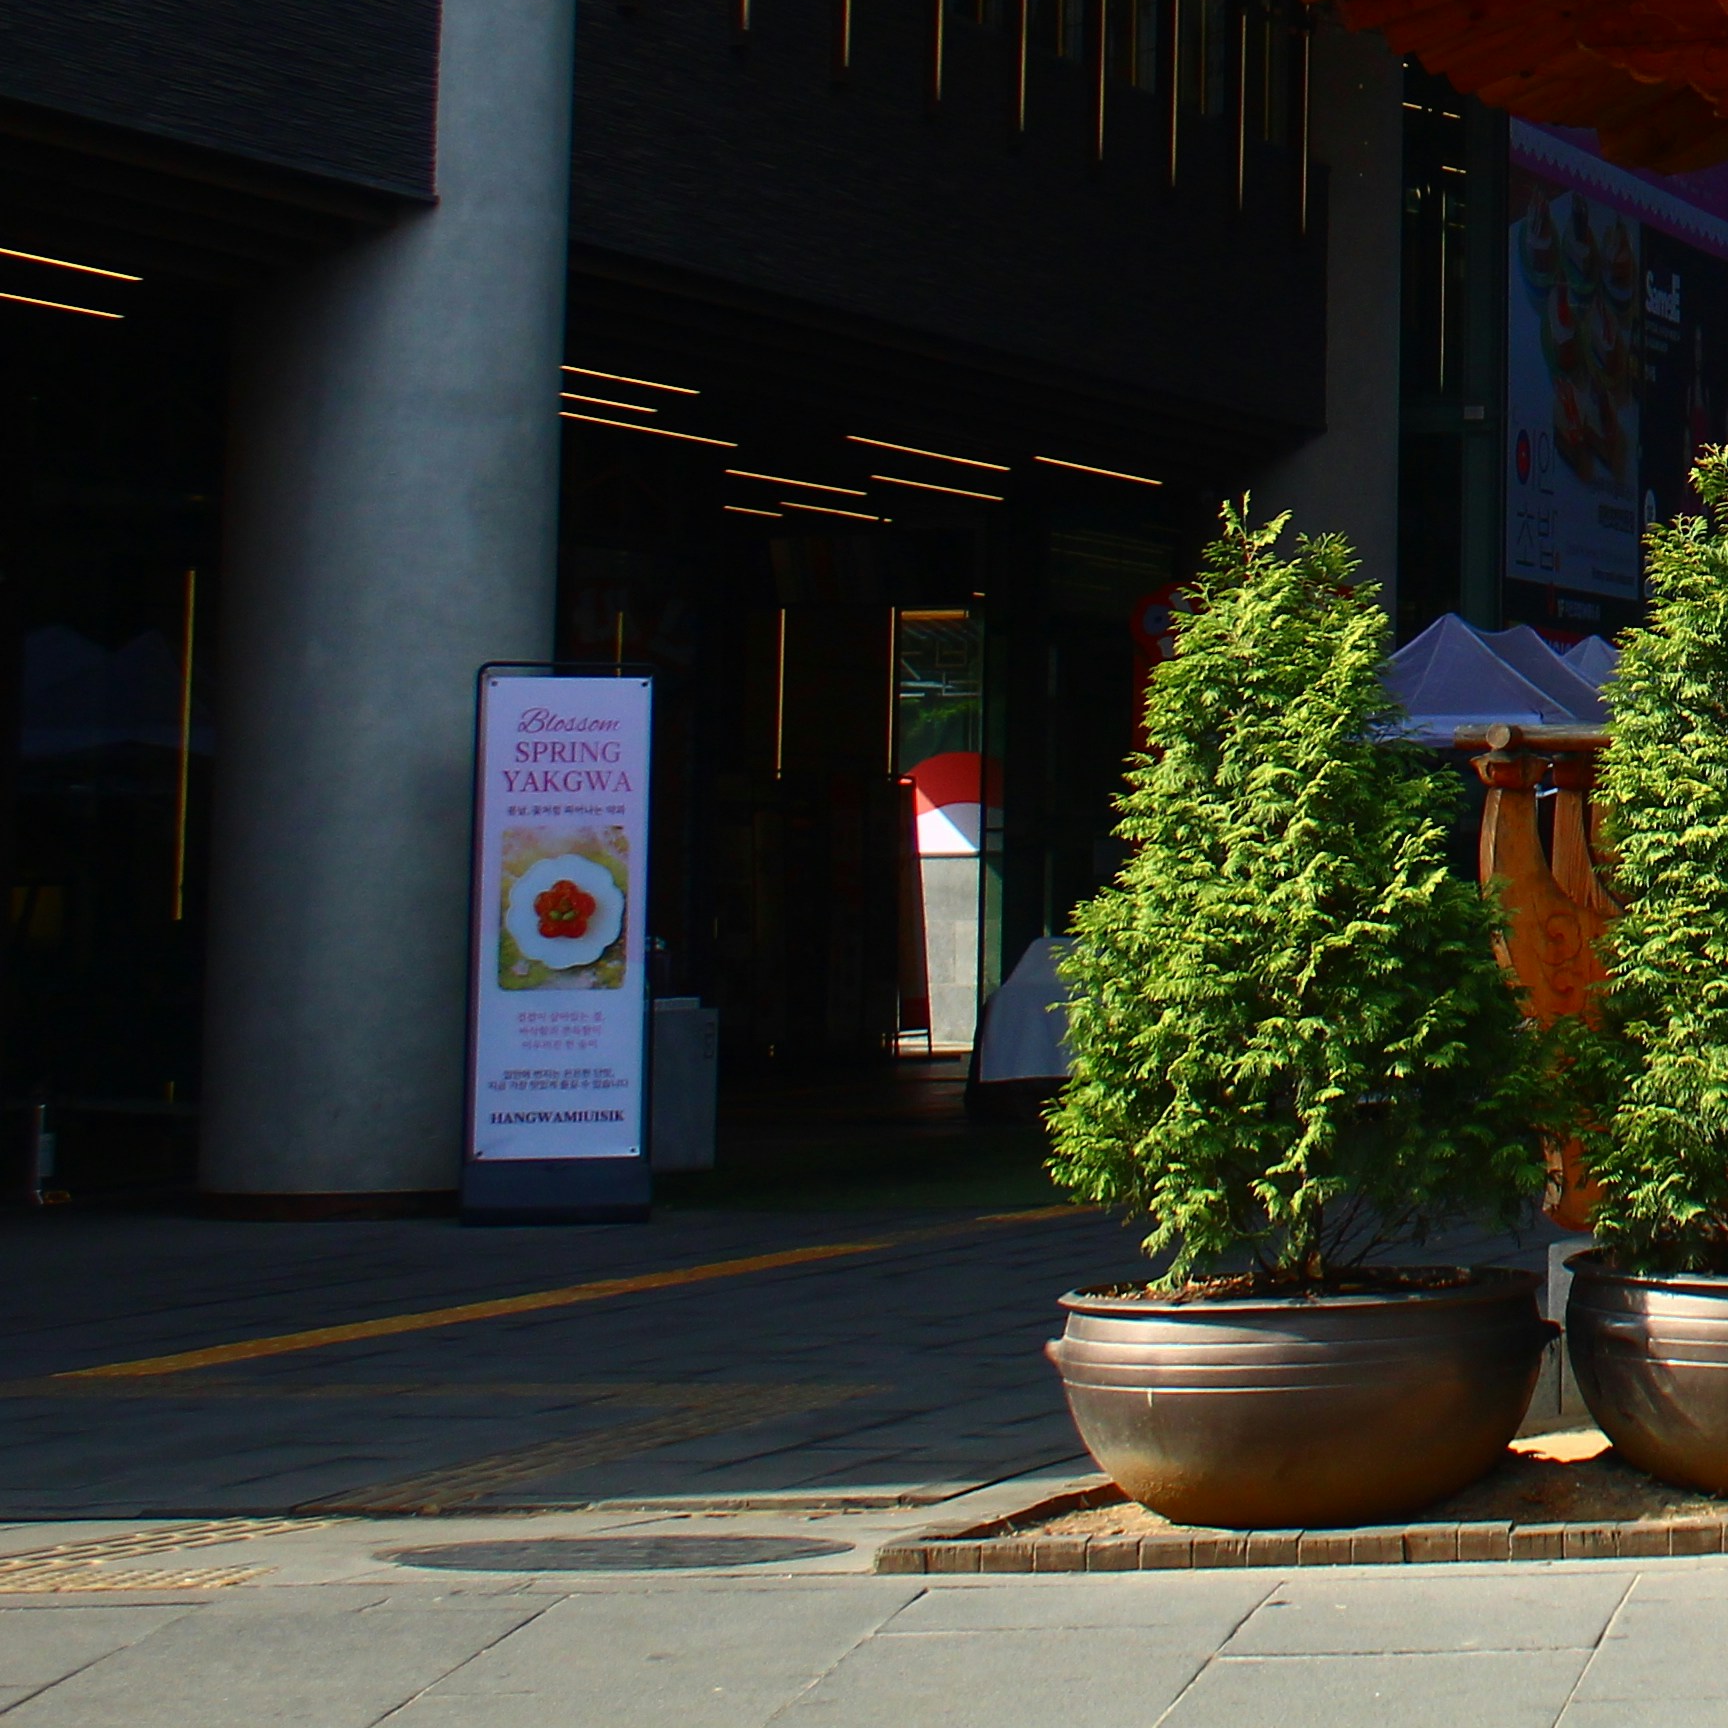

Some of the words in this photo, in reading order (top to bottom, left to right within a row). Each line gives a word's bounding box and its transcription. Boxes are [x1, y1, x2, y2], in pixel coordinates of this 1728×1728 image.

[518, 707, 620, 734] Blossom
[515, 741, 621, 763] SPRING
[503, 770, 634, 792] YAKGWA
[490, 1110, 625, 1124] HANGWAMIUISIK
